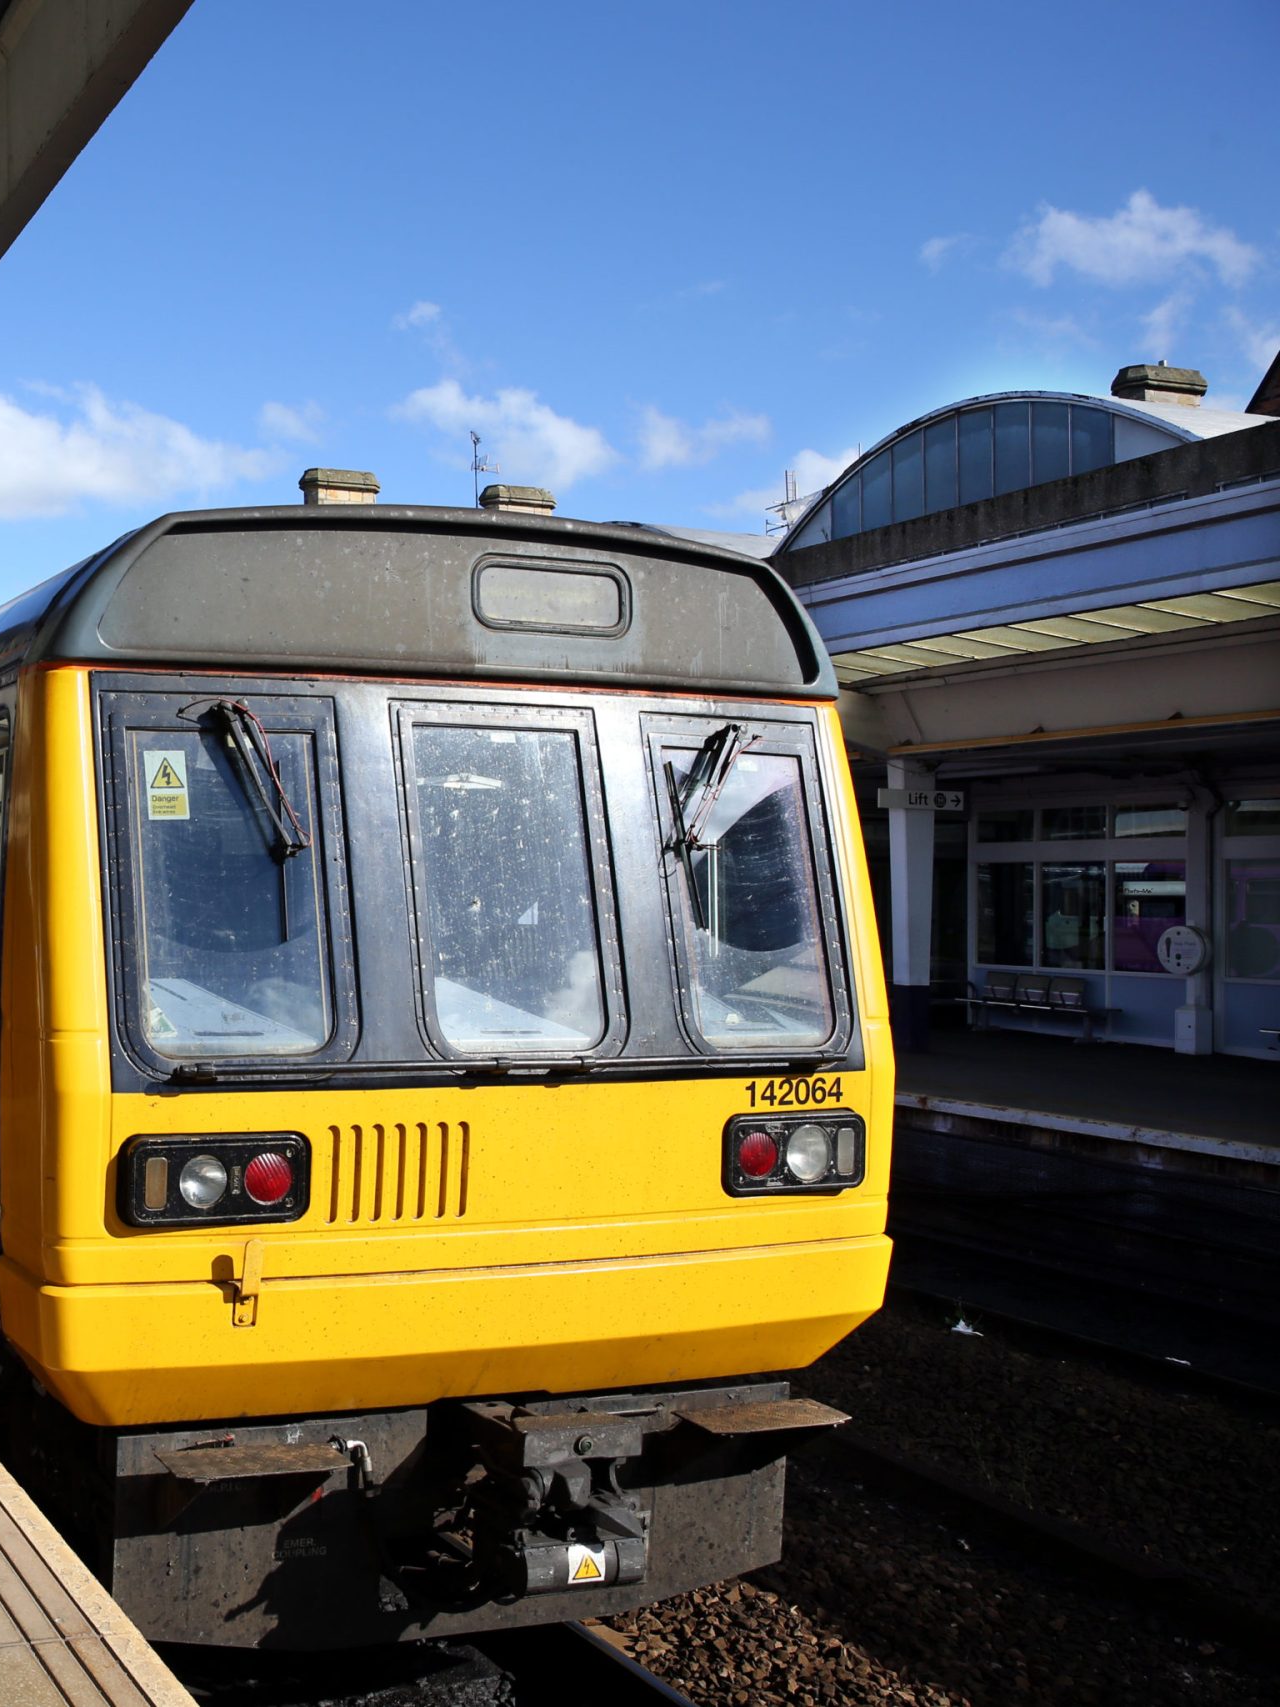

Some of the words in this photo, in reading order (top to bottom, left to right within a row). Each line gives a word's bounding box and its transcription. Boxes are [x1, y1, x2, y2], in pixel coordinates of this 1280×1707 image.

[152, 795, 179, 803] Danger
[908, 792, 928, 806] Lift
[745, 1077, 843, 1107] 142064
